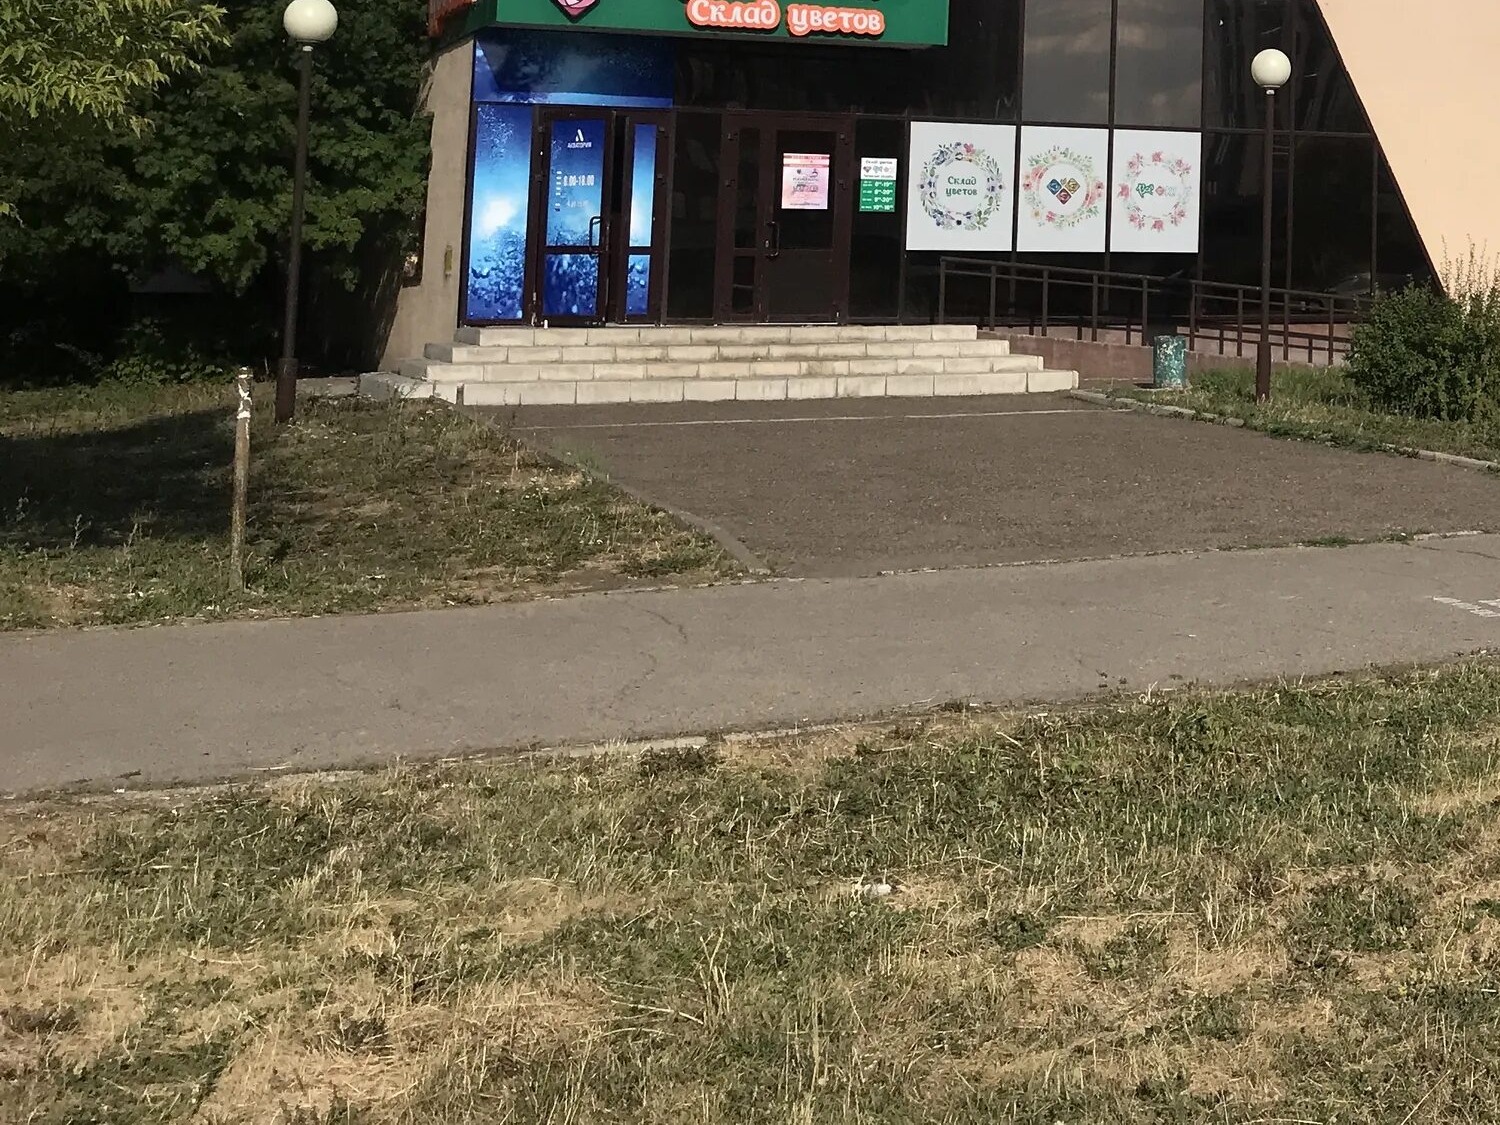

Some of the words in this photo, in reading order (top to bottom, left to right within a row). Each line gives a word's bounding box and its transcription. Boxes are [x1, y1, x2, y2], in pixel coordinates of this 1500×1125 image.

[790, 11, 882, 35] цветов
[947, 175, 977, 185] Склад
[945, 187, 978, 197] цветов
